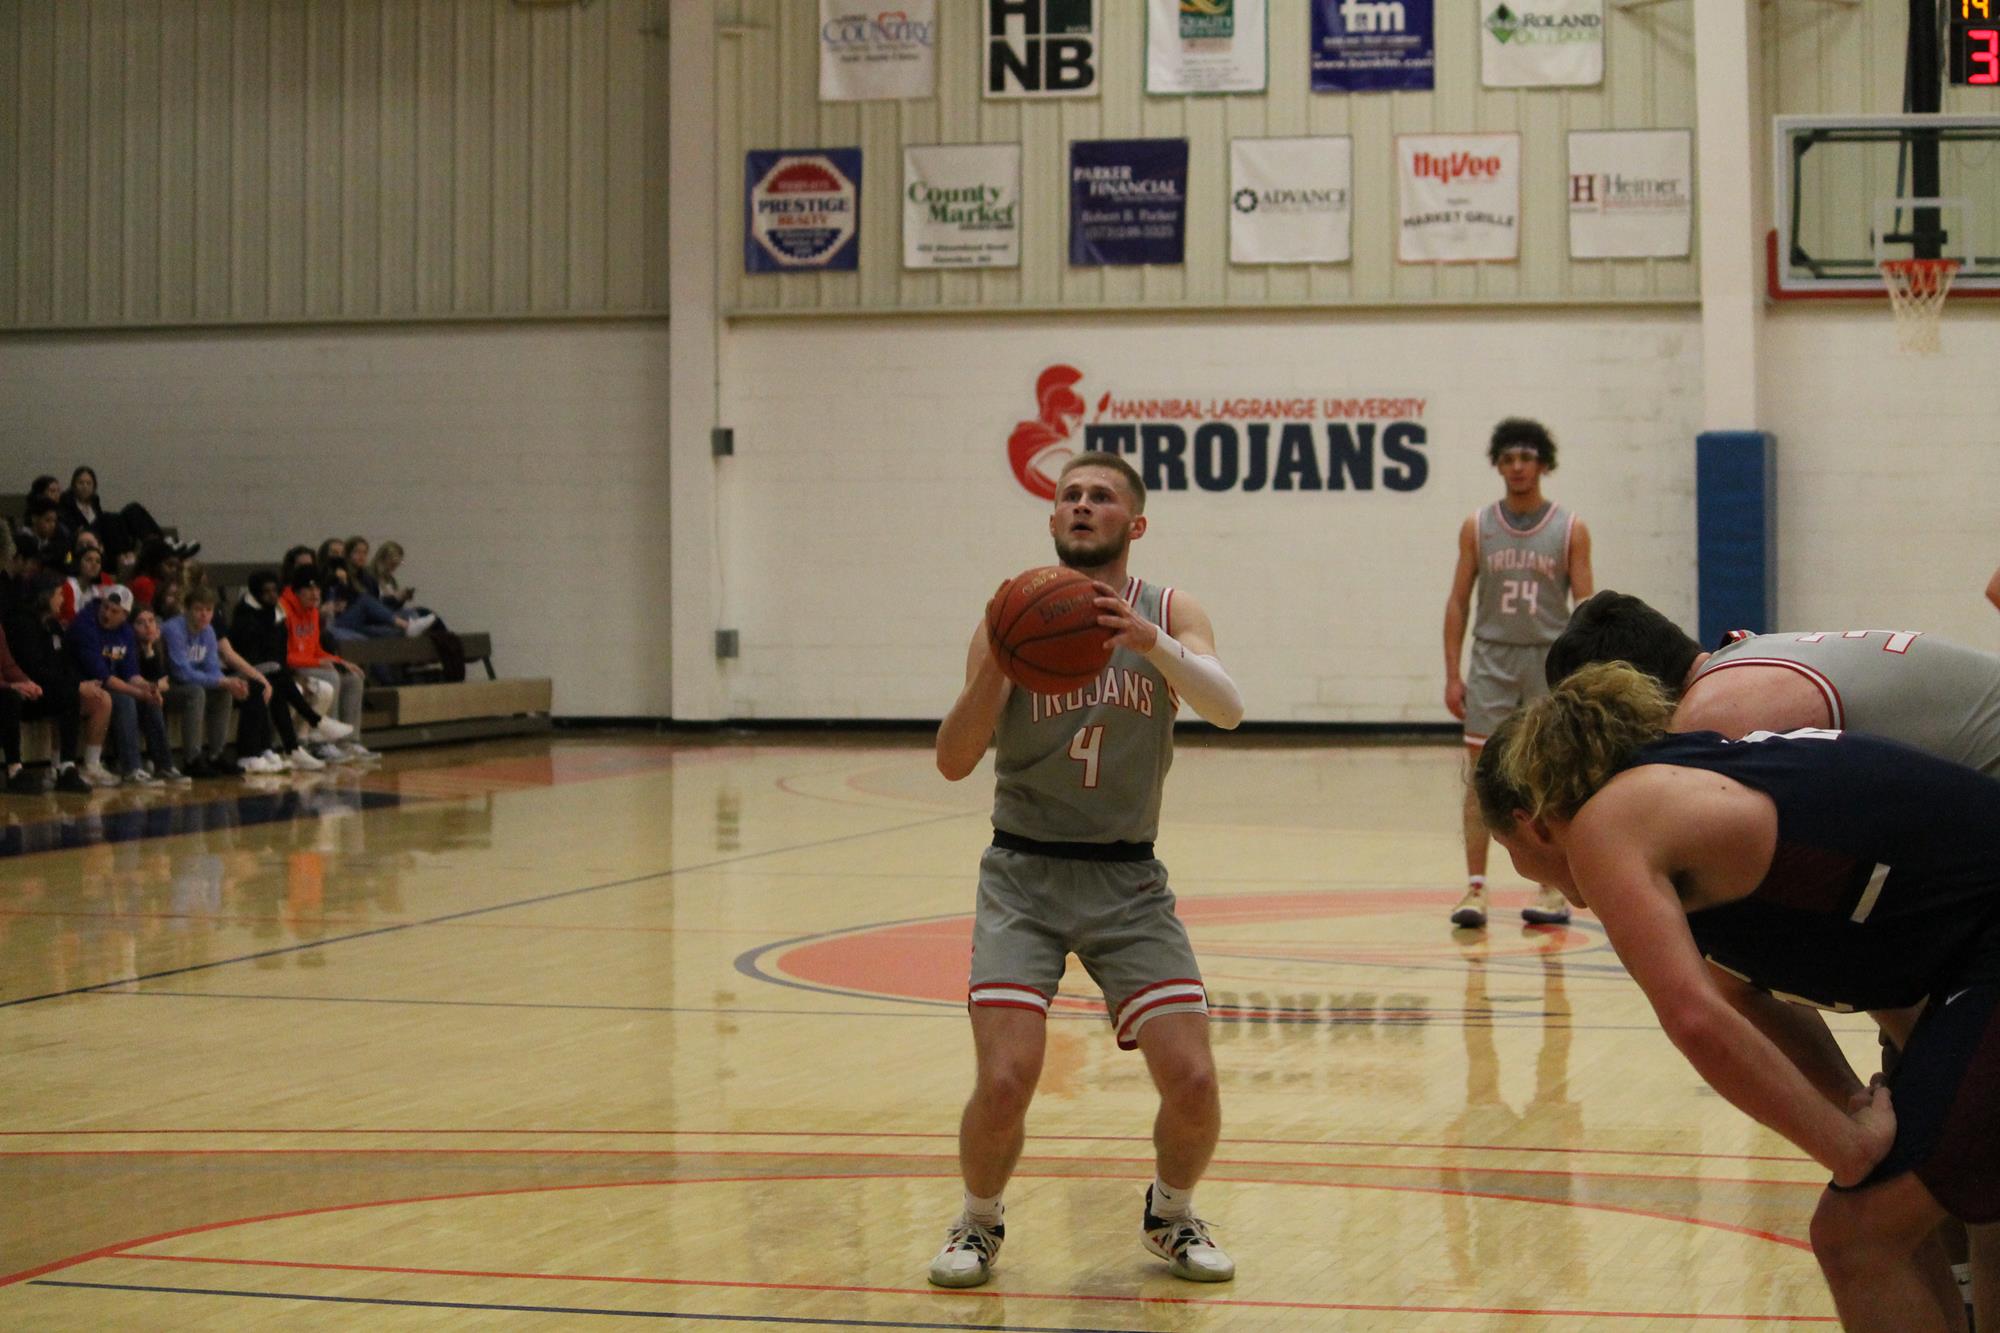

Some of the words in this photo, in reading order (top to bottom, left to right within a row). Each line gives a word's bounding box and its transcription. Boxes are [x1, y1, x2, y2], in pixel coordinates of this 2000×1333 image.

[1967, 29, 1999, 83] 3
[1073, 166, 1132, 182] PARKER
[908, 181, 1001, 208] County
[1089, 179, 1176, 196] FINANCIAL
[1262, 188, 1346, 204] ADVANCE
[758, 197, 850, 214] PRESTIGE
[927, 200, 1015, 224] Market
[1403, 211, 1460, 228] MARKET
[1465, 210, 1514, 229] GRILLE
[1323, 397, 1426, 420] UNIVERSITY
[1084, 422, 1429, 492] TROJANS
[1487, 548, 1557, 581] TROJANS
[1501, 580, 1539, 616] 24
[1068, 724, 1105, 789] 4
